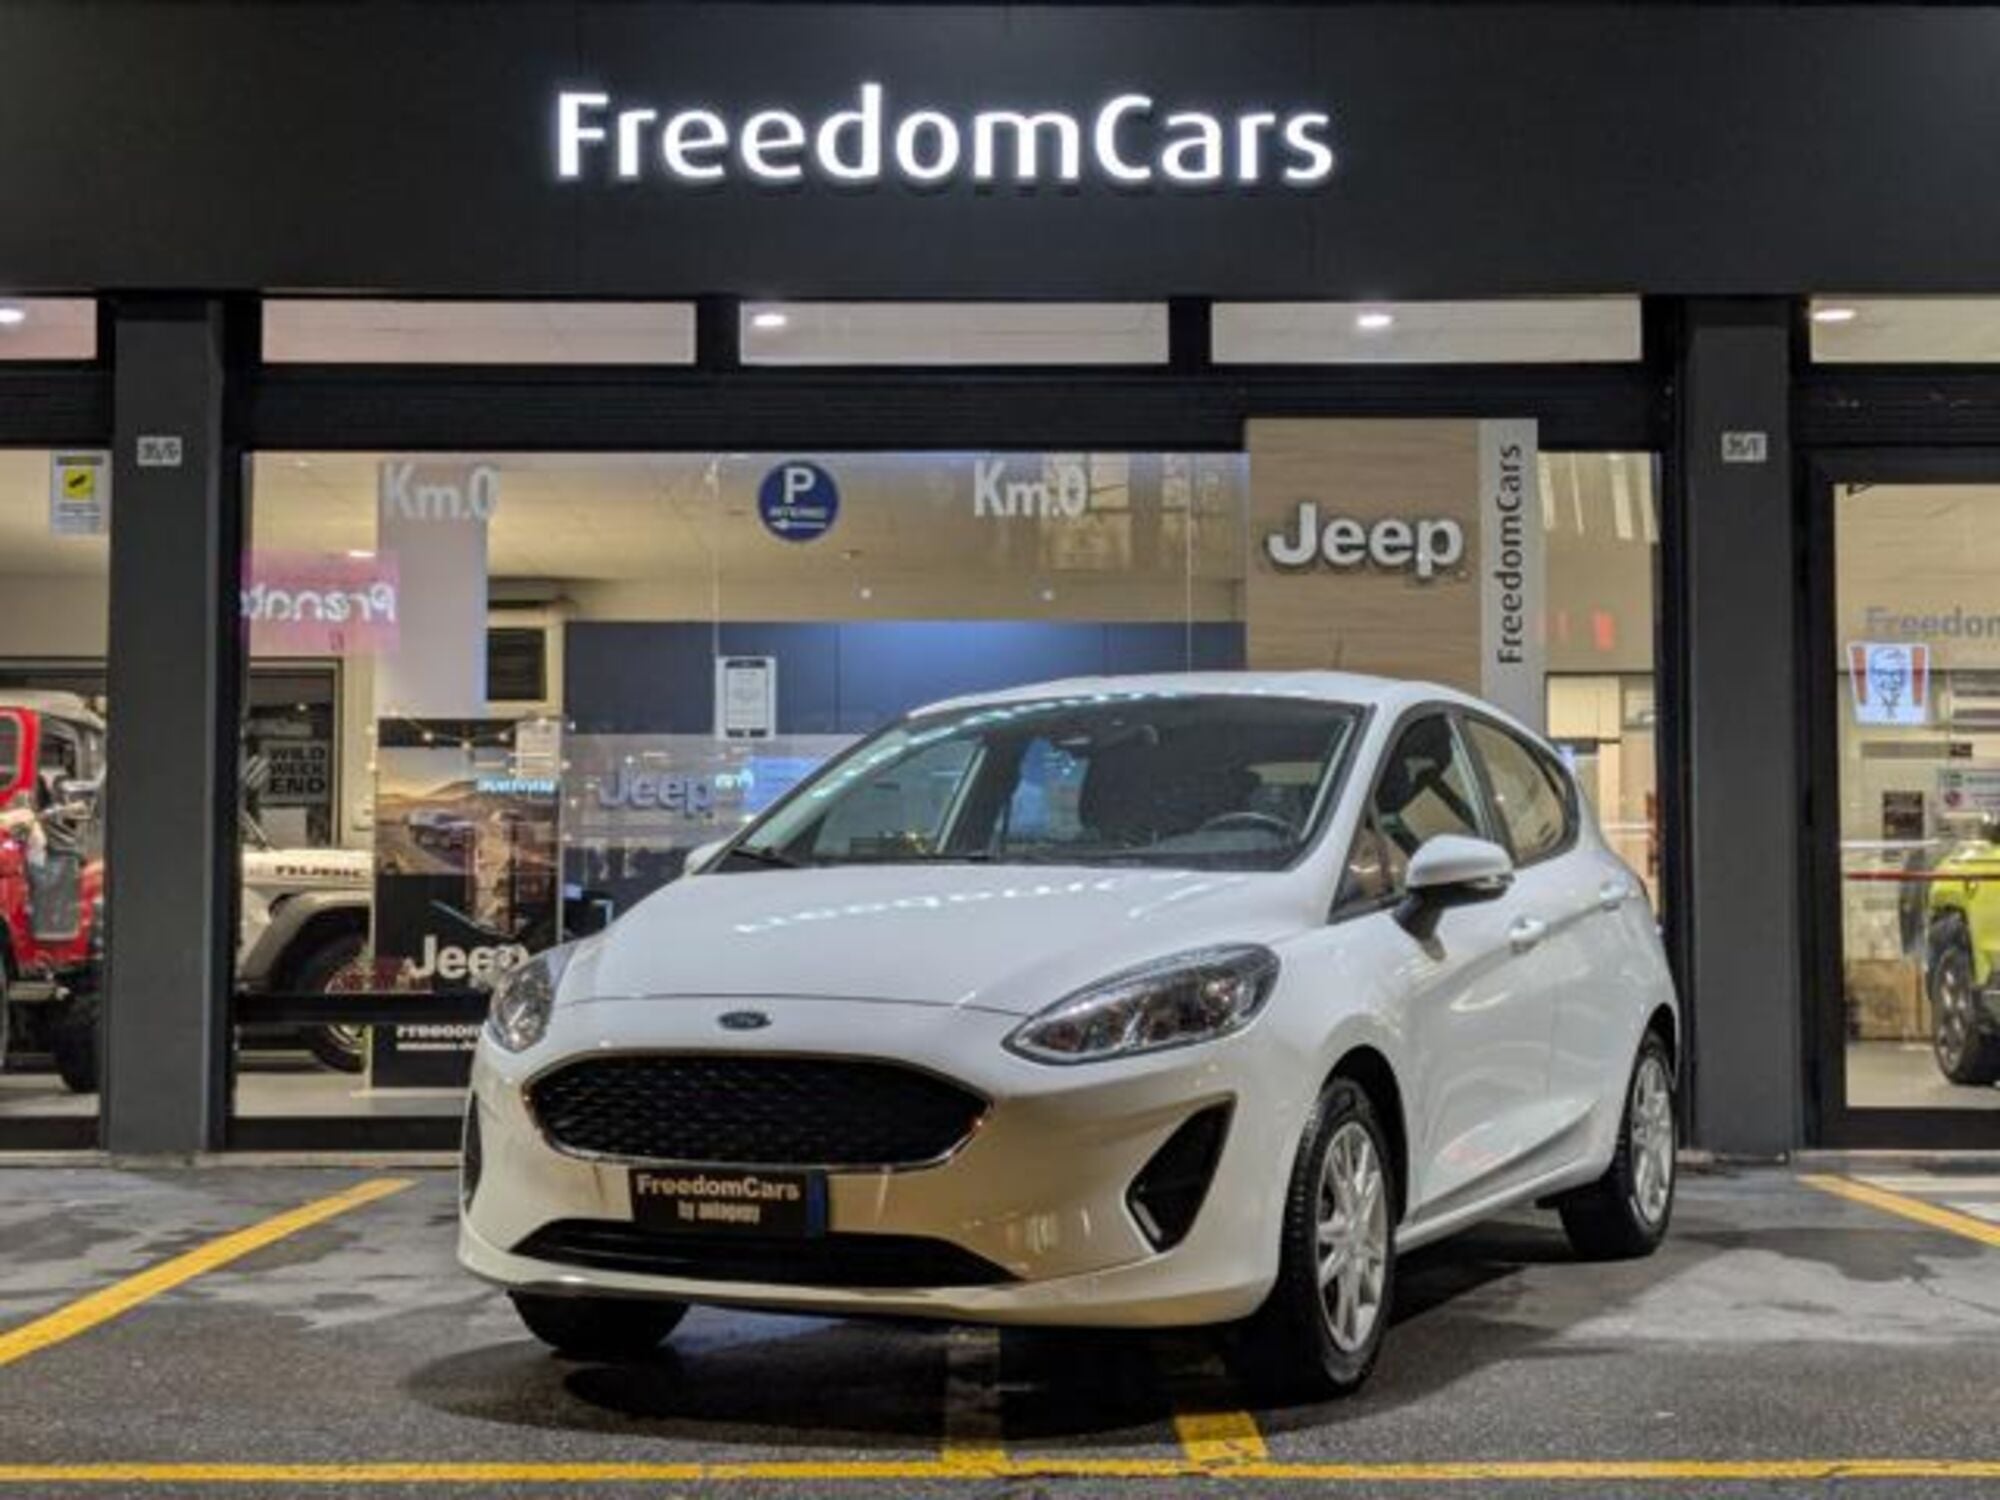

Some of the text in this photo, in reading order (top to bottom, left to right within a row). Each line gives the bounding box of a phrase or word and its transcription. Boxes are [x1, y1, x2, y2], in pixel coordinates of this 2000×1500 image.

[555, 83, 1335, 183] FreedomCars
[784, 467, 815, 504] P
[974, 459, 1087, 517] Km.0
[1267, 501, 1463, 577] Jeep
[1494, 443, 1523, 664] FreedomCars
[270, 746, 326, 761] WILD
[270, 778, 326, 795] END
[600, 764, 713, 818] Jeep
[636, 1173, 800, 1199] FreedomCars
